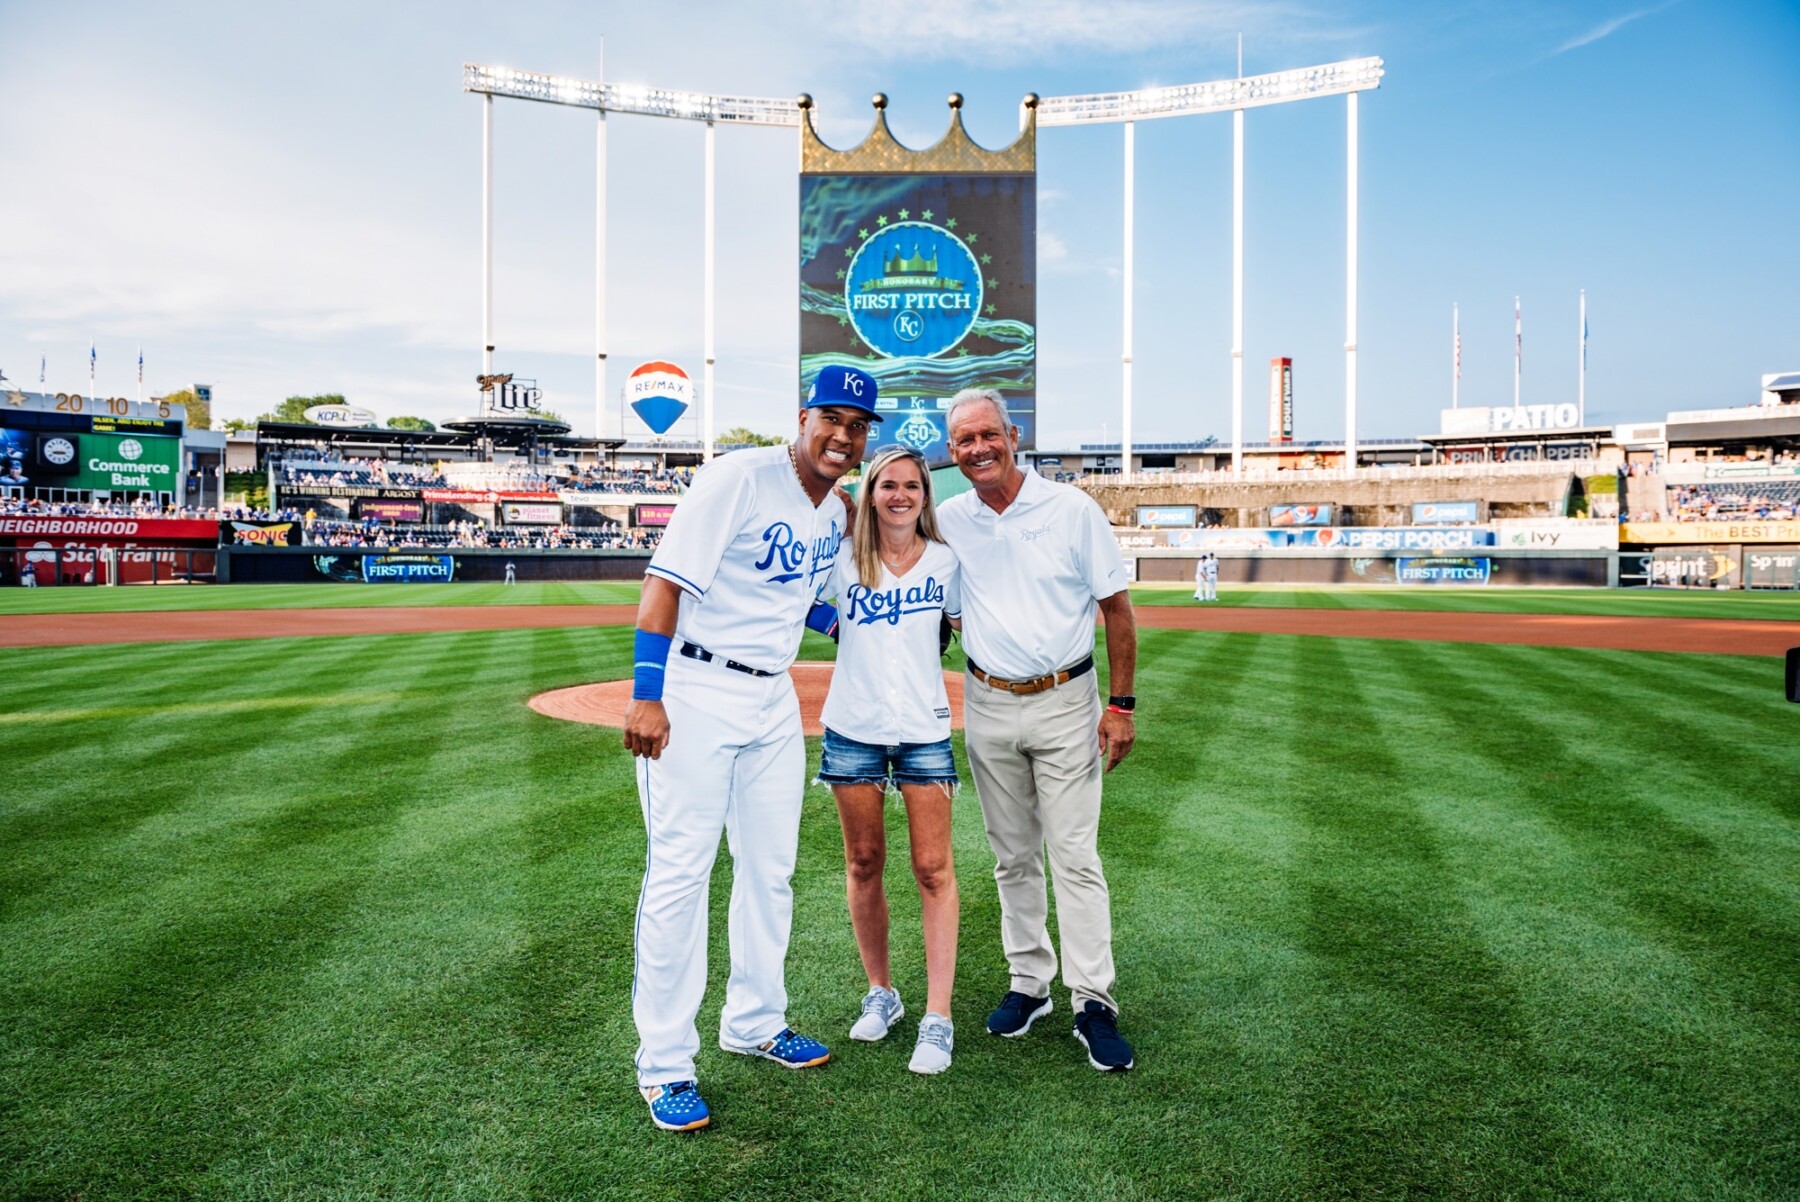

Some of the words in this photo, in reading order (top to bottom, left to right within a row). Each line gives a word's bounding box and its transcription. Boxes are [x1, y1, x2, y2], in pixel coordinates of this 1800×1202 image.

[883, 277, 936, 286] HONORARY
[853, 293, 900, 310] FIRST
[904, 293, 971, 309] PITCH
[900, 316, 918, 337] KC
[635, 381, 684, 393] RE/MAX
[843, 372, 864, 396] KC
[55, 393, 83, 413] 20
[106, 397, 129, 416] 10
[490, 383, 542, 413] Lite
[158, 401, 171, 419] 5
[1492, 402, 1579, 431] PATIO
[908, 424, 929, 440] 50
[1509, 447, 1590, 461] CHPPER
[89, 458, 170, 475] Commerce
[111, 473, 150, 487] Bank
[382, 489, 417, 498] ARGOSY
[423, 490, 484, 502] PrimeLending
[238, 529, 287, 541] SONIC
[1350, 531, 1402, 549] PEPSI
[1405, 530, 1473, 548] PORCH
[1696, 527, 1725, 538] The
[1729, 526, 1774, 538] BEST
[755, 520, 842, 587] Royals
[369, 565, 405, 576] FIRST
[408, 565, 448, 576] PITCH
[1402, 568, 1440, 579] FIRST
[1442, 568, 1484, 579] PITCH
[847, 576, 944, 626] Royals
